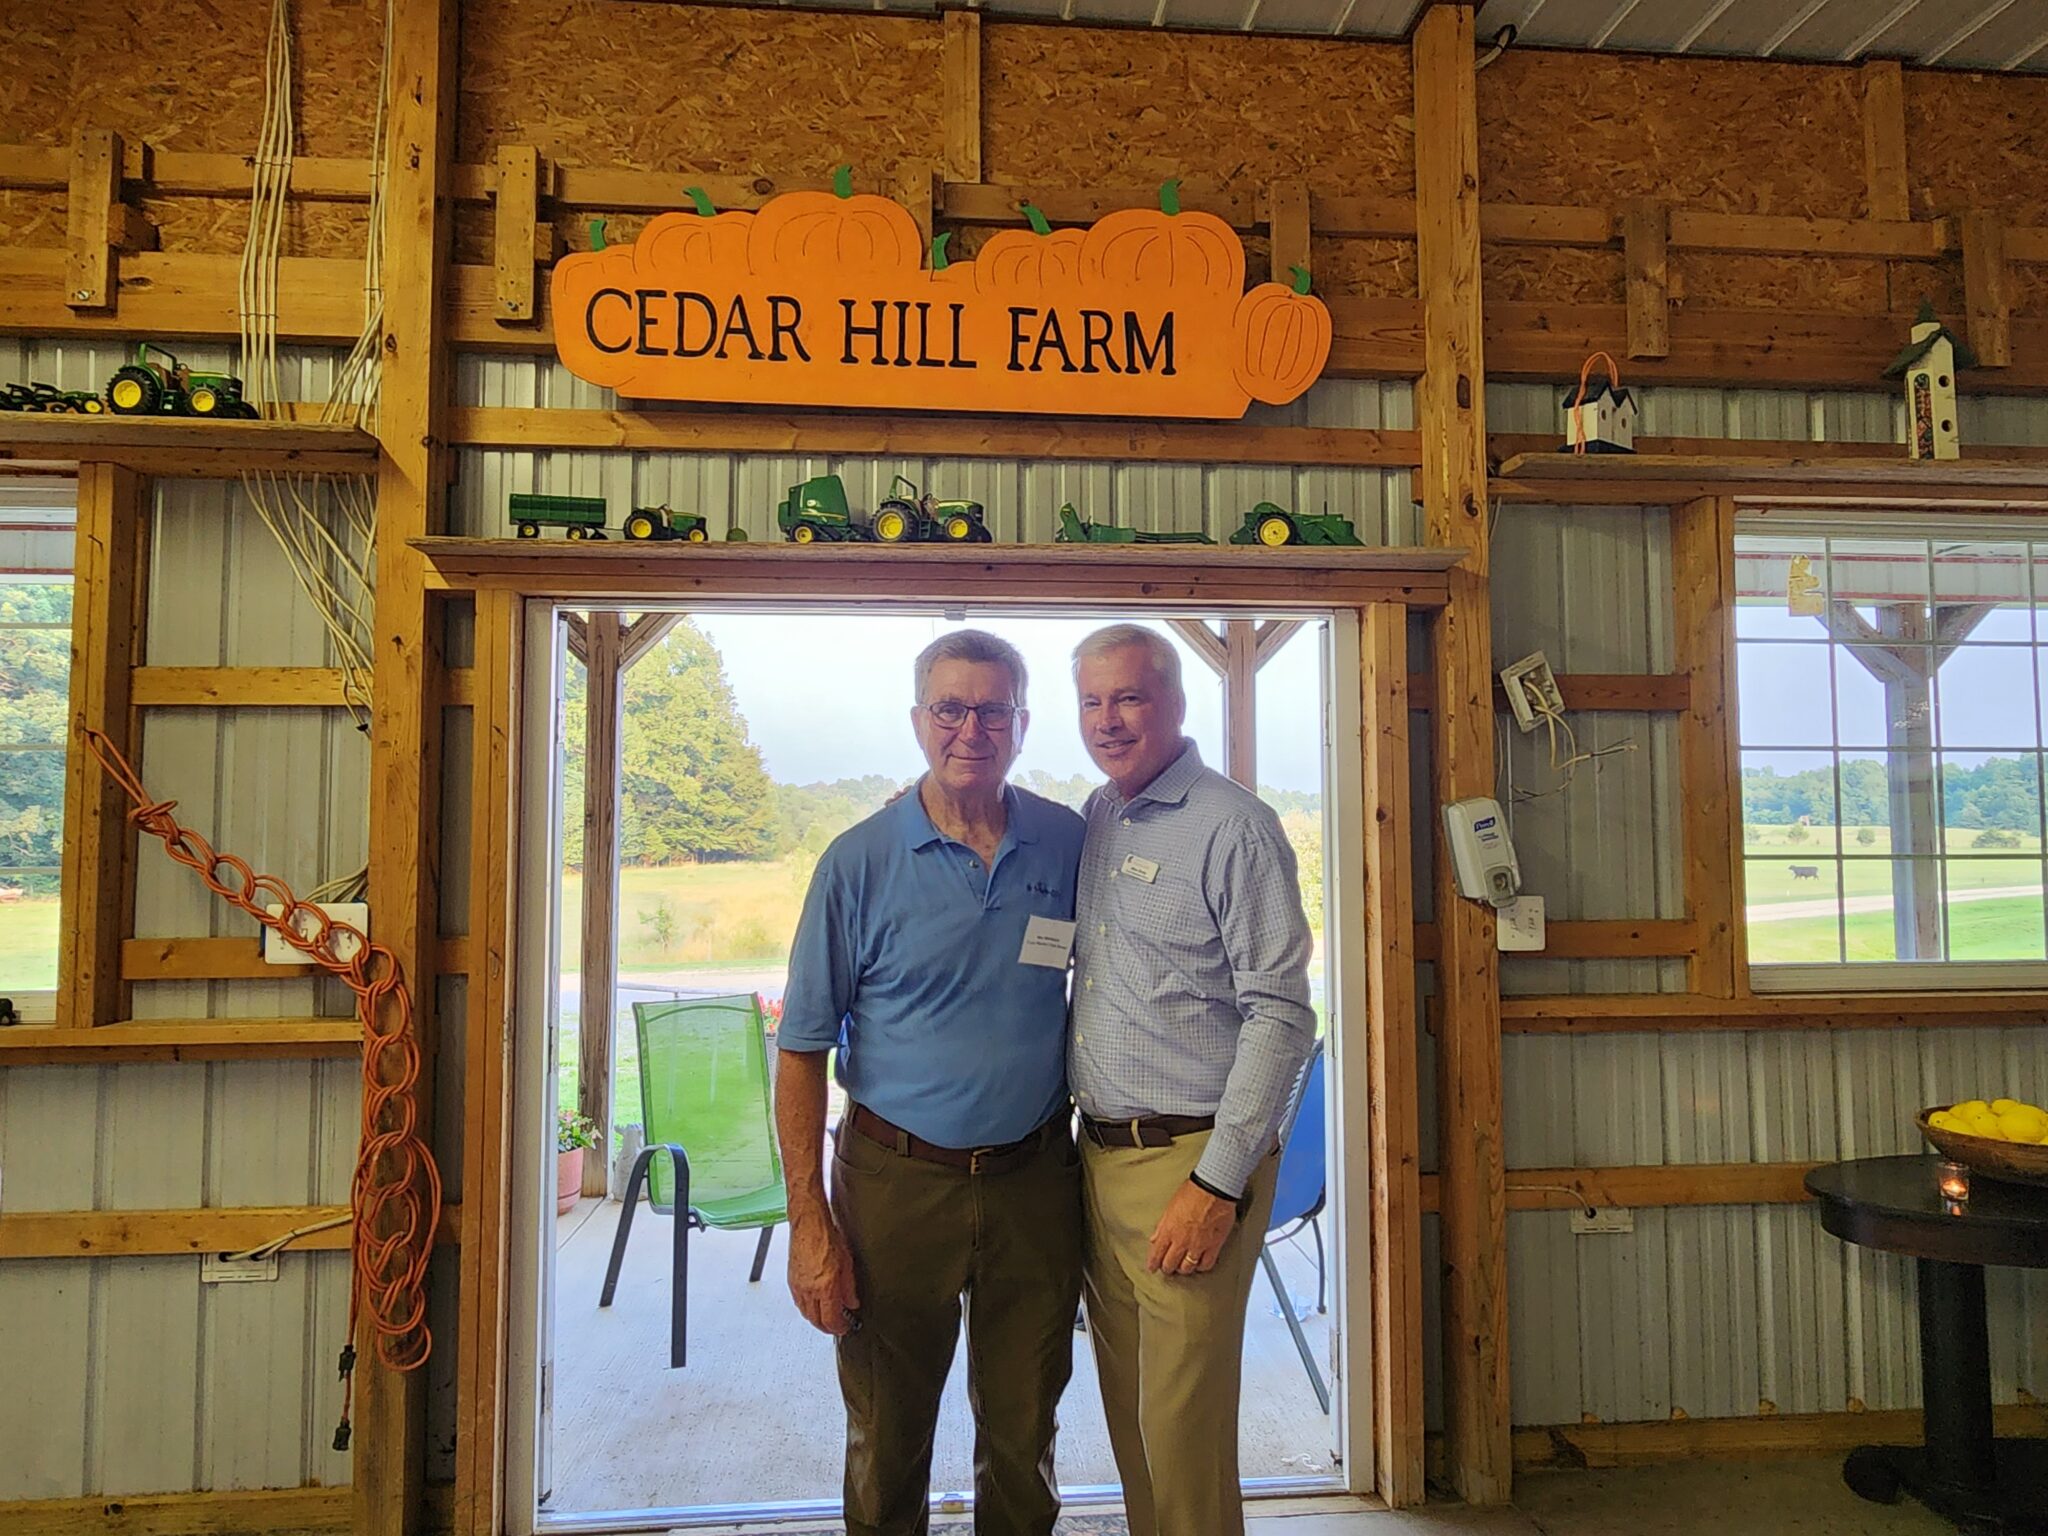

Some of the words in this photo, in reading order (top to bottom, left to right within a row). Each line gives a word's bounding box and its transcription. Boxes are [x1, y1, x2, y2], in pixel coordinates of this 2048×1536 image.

[586, 288, 812, 362] CEDAR
[838, 299, 978, 369] HILL
[1007, 306, 1178, 376] FARM
